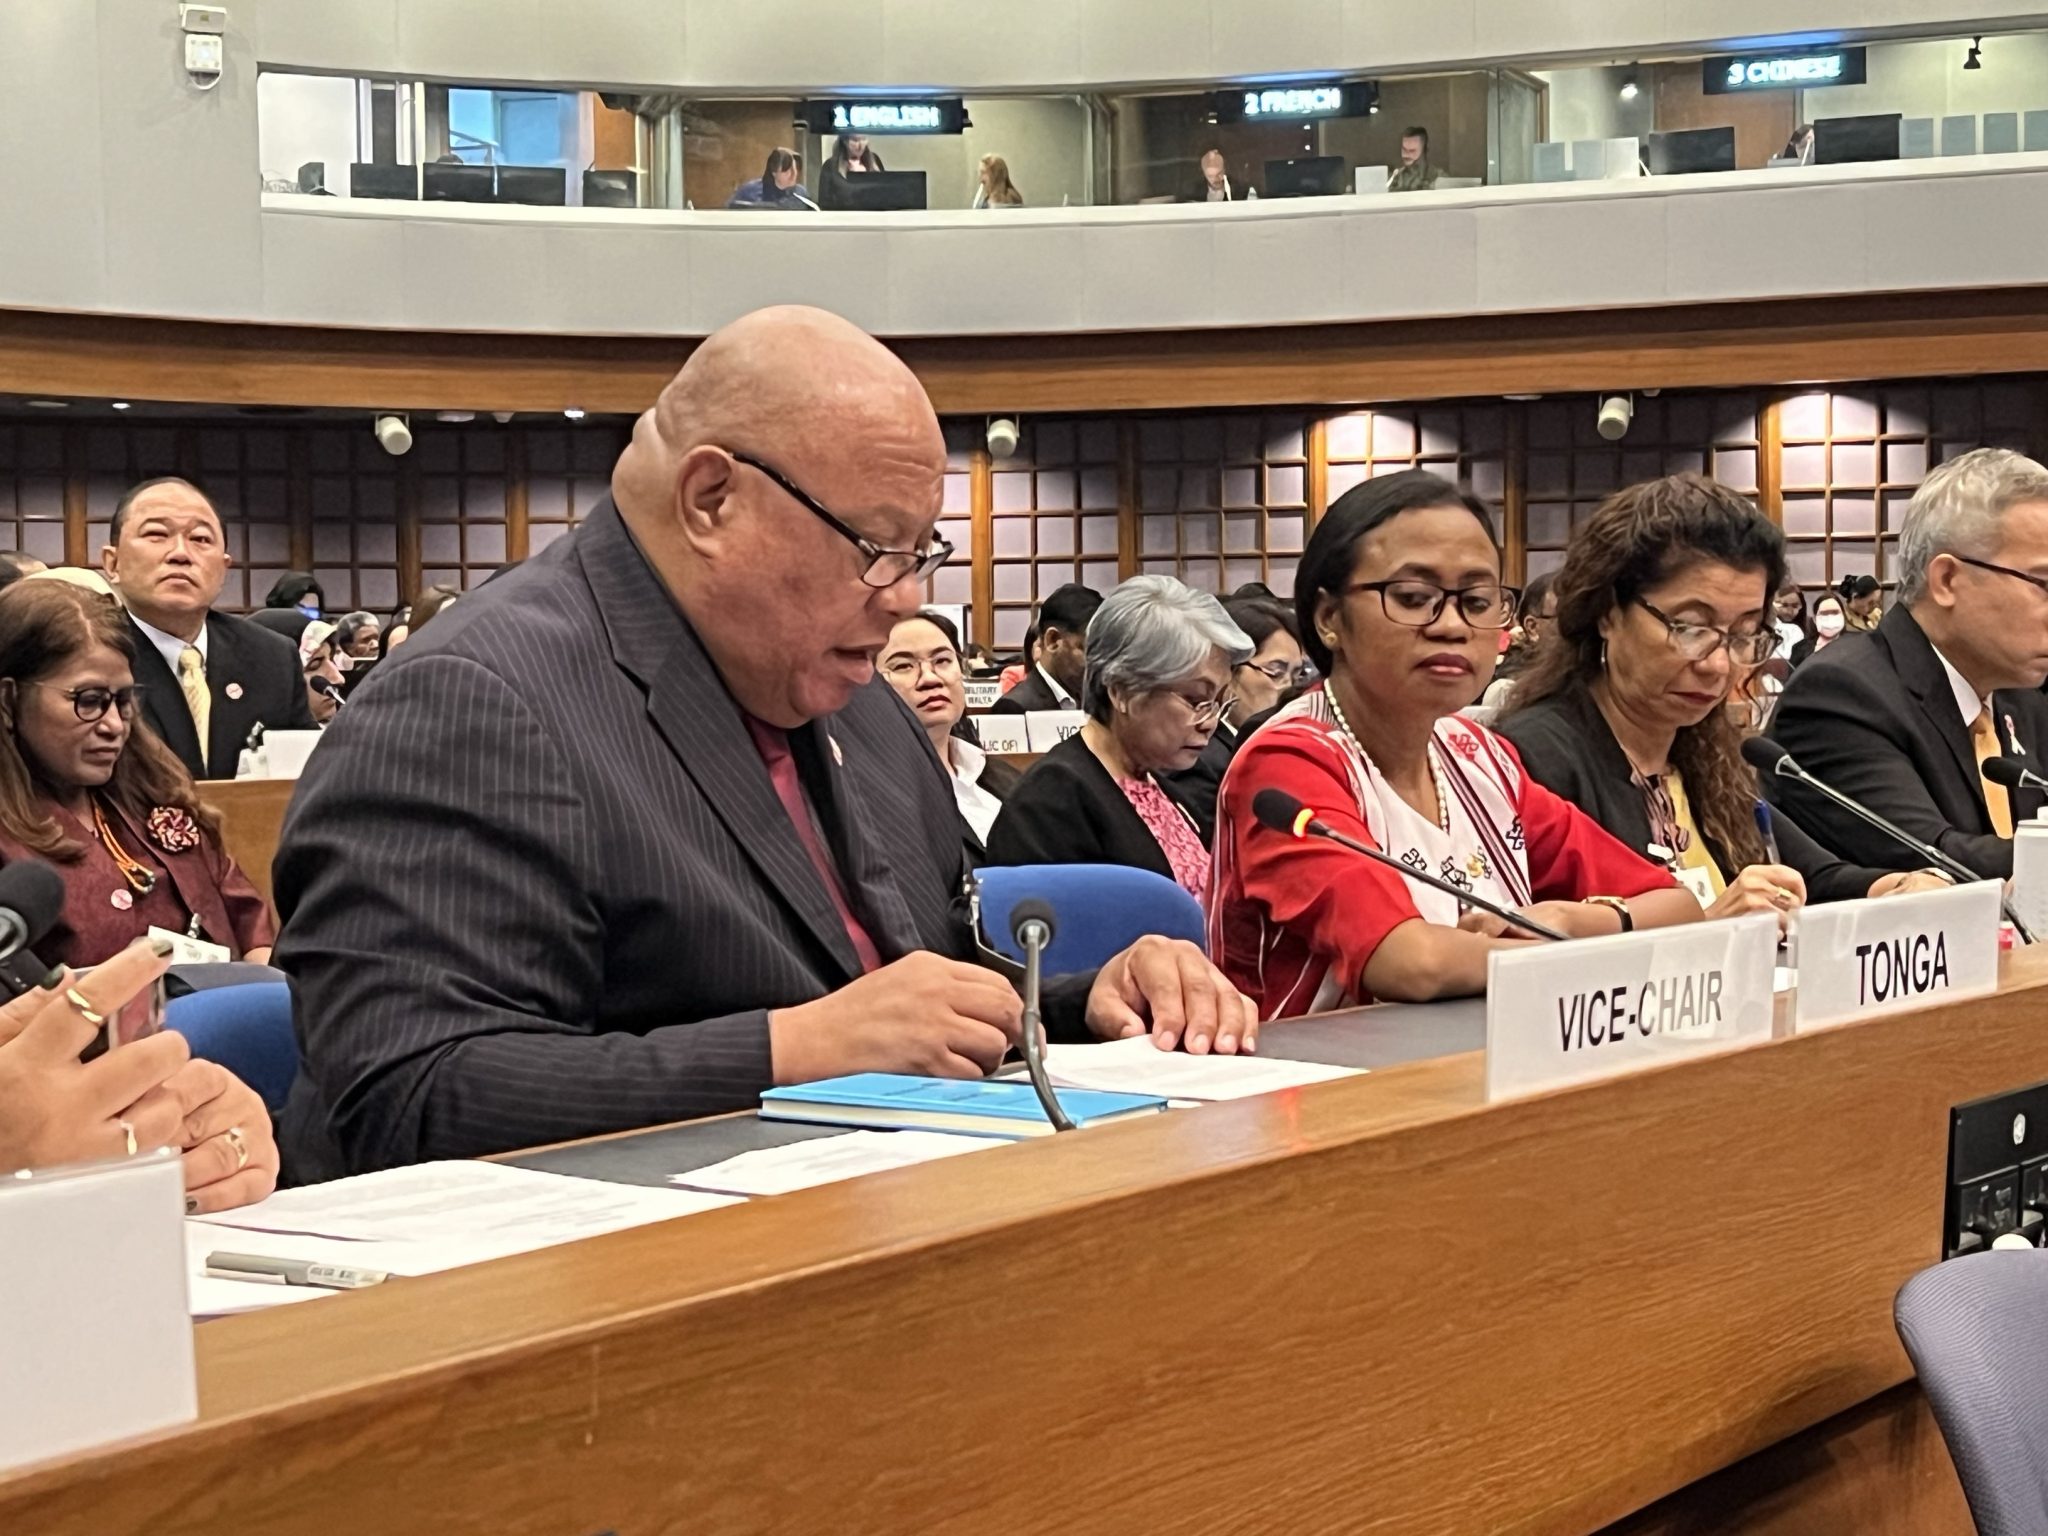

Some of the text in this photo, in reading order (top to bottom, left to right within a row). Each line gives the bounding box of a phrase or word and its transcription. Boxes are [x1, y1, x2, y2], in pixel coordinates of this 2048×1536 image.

[1727, 55, 1841, 85] 3 CHINESE
[1244, 87, 1341, 114] 2 FRENCH
[850, 105, 940, 127] ENGLISH
[981, 739, 999, 752] LIC
[1855, 931, 1949, 1006] TONGA
[1557, 970, 1723, 1052] VICE-CHAIR
